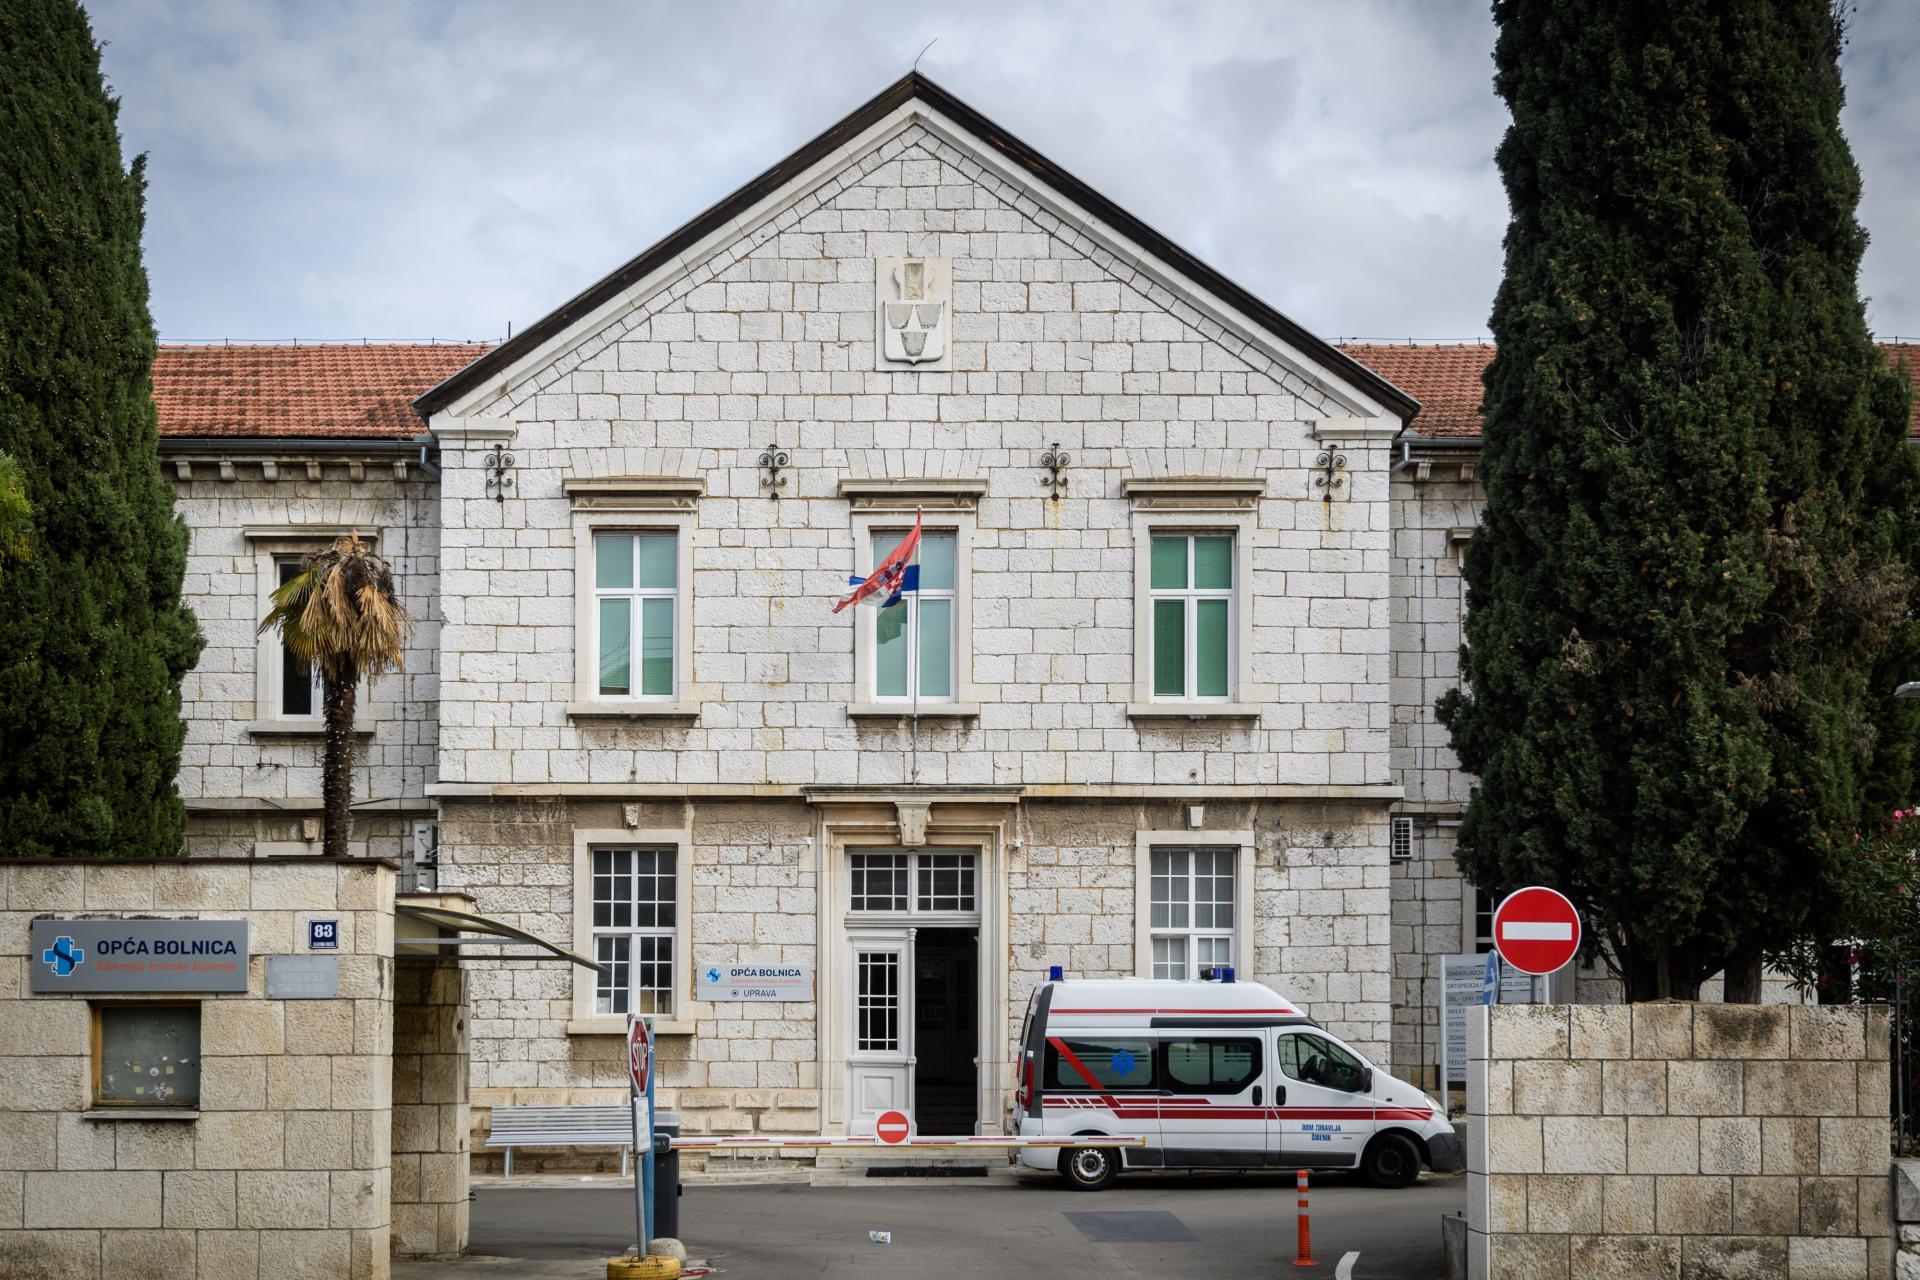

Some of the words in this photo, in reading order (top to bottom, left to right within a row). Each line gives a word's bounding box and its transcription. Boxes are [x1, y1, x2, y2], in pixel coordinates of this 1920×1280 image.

[314, 924, 333, 938] 83
[97, 937, 150, 955] OPĆA
[153, 940, 237, 955] BOLNICA
[731, 967, 757, 976] OPĆA
[743, 989, 776, 997] UPRAVA
[632, 1042, 648, 1071] STOP
[1312, 1132, 1331, 1141] ŠIBENIK
